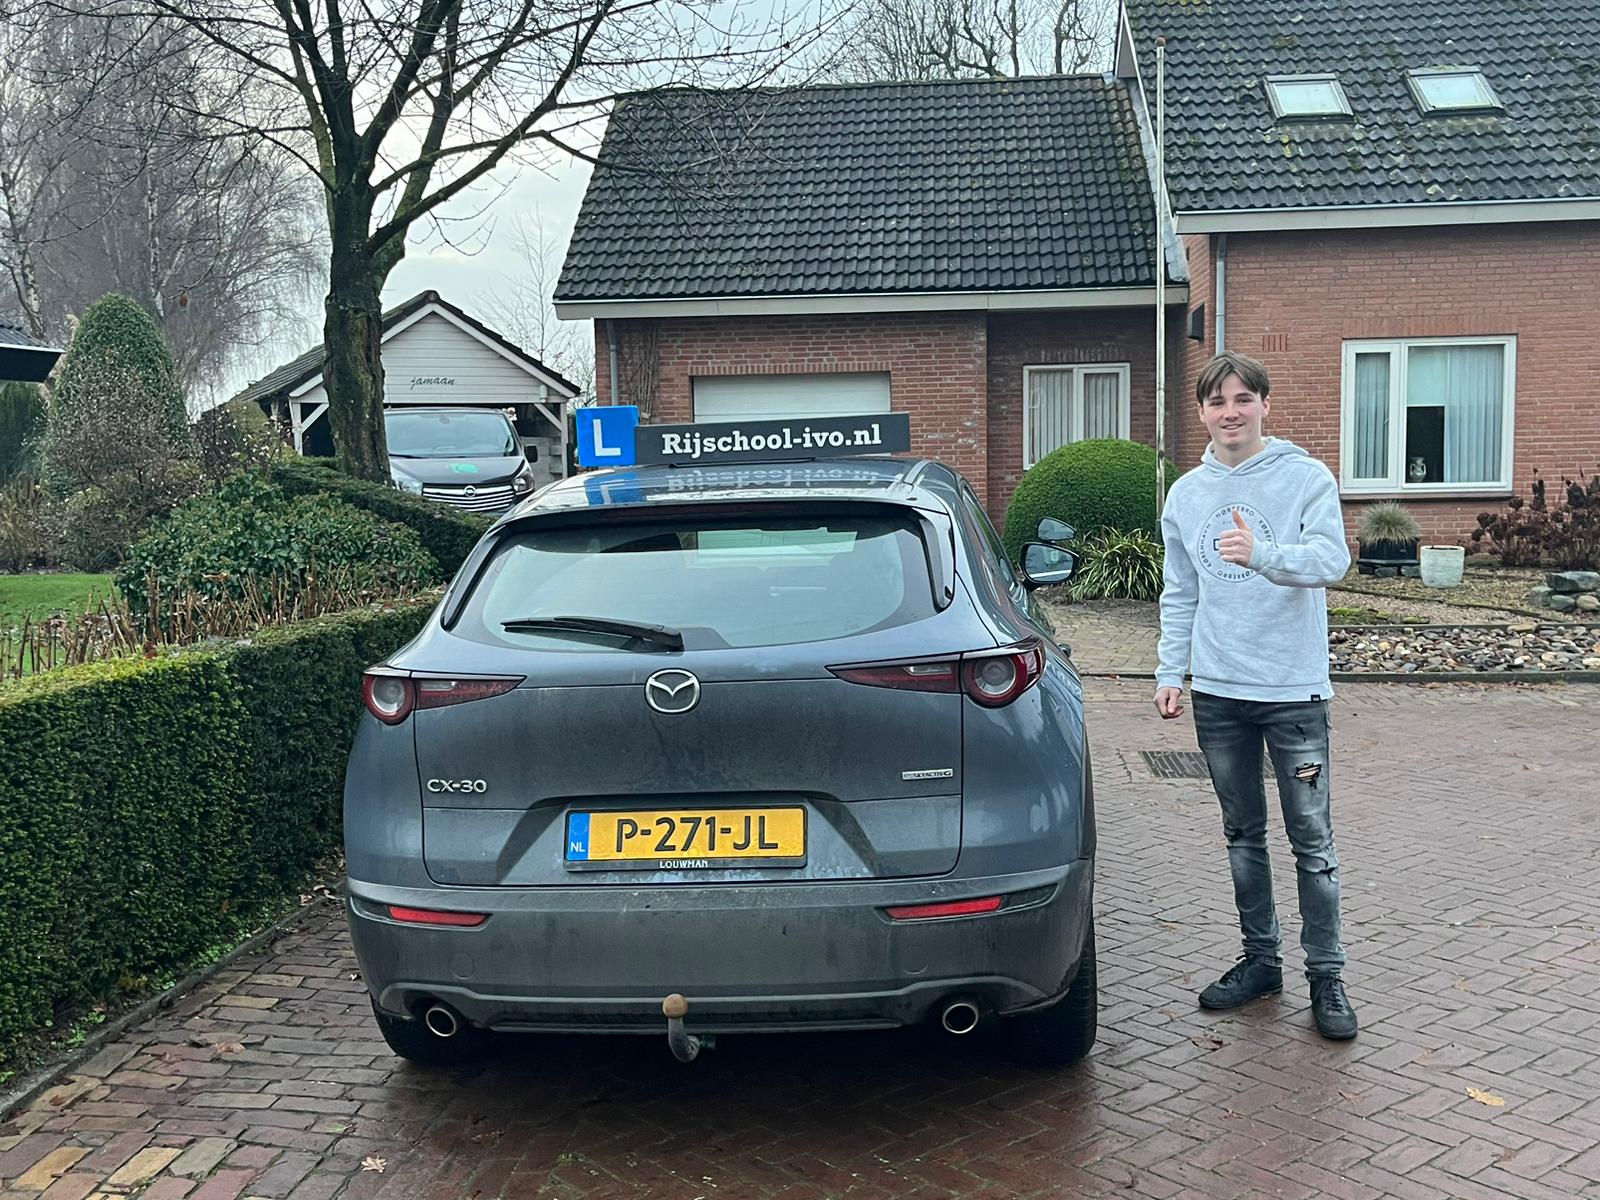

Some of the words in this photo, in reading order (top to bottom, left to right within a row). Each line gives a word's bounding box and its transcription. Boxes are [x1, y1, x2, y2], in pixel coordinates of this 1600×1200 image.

[593, 419, 621, 457] L
[661, 423, 882, 459] Rijschool-ivo.nl
[427, 779, 487, 793] CX-30
[570, 842, 586, 853] NL
[615, 815, 779, 853] P-271-JL
[659, 859, 709, 869] LOUWMAN
